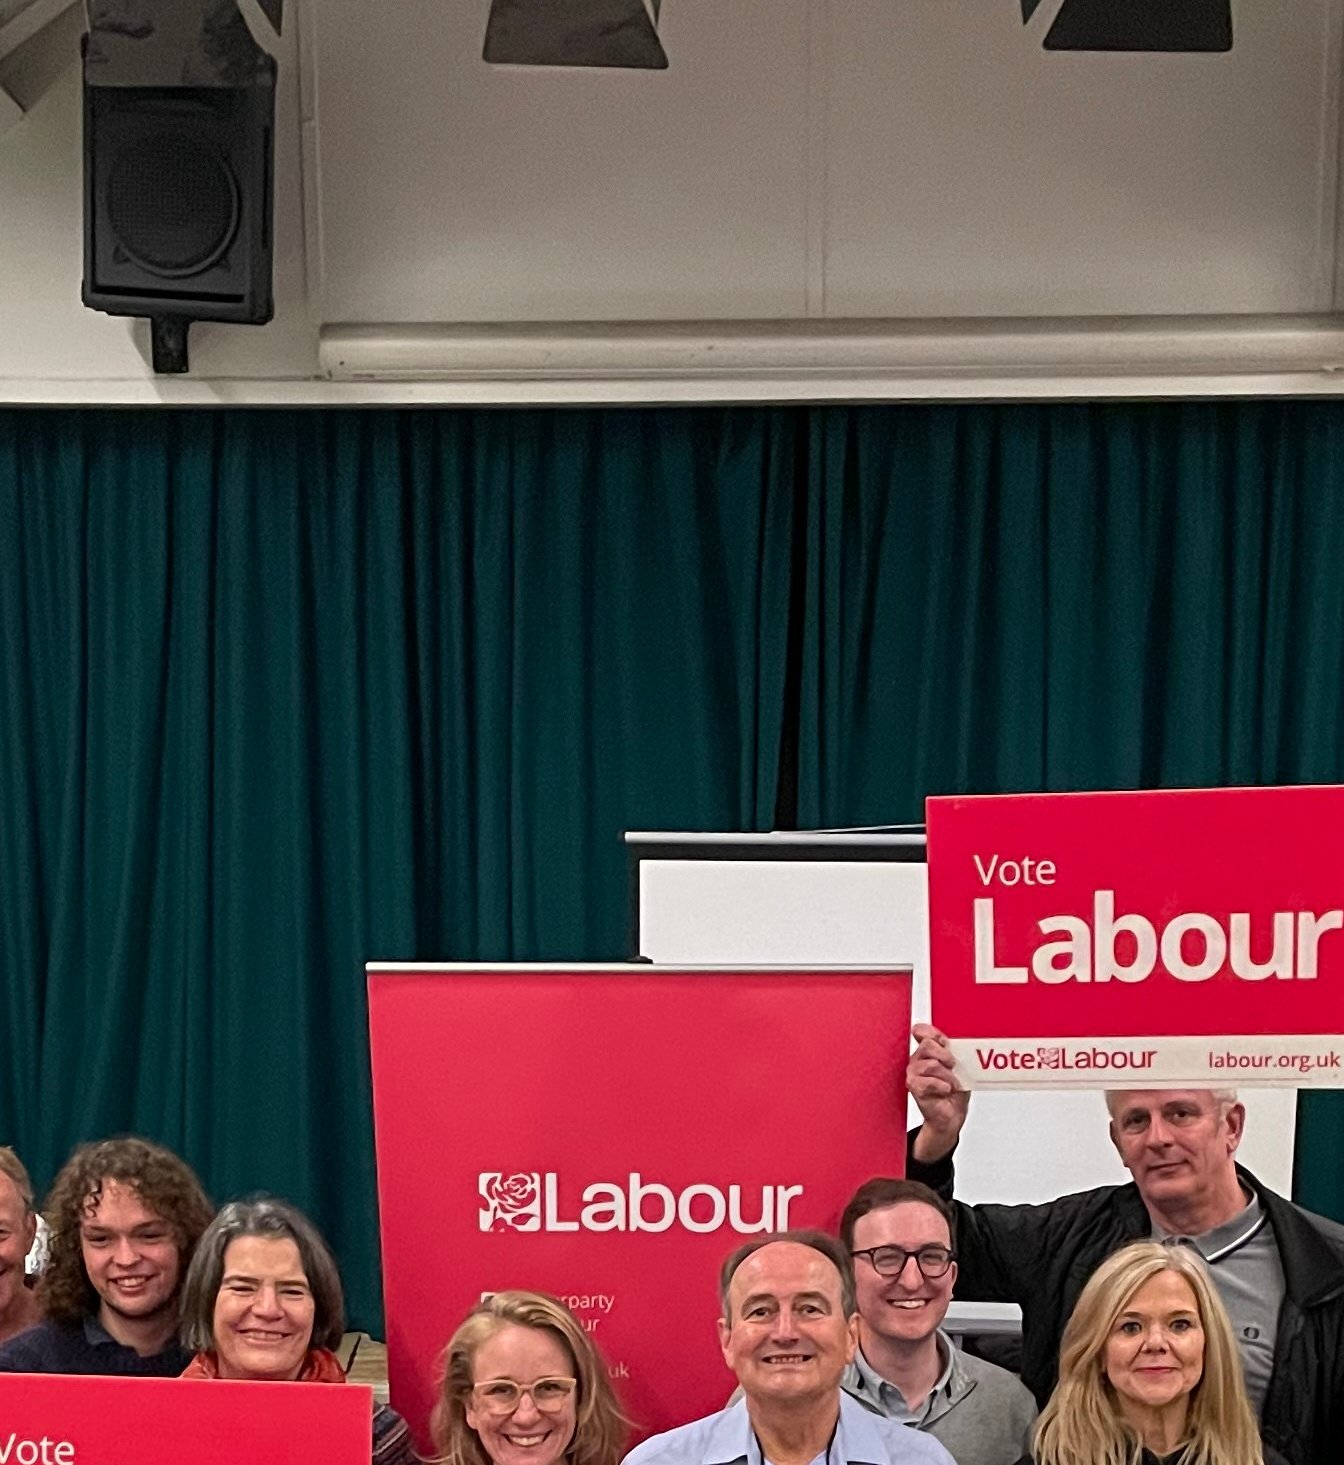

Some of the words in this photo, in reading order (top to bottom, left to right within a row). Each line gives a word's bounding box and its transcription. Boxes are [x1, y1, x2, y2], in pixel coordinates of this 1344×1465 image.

[973, 854, 1056, 886] Vote
[973, 889, 1344, 985] Labour
[976, 1048, 1035, 1070] Vote
[1061, 1047, 1158, 1070] Labour
[1208, 1050, 1341, 1072] labour.org.uk
[545, 1172, 803, 1234] Labour
